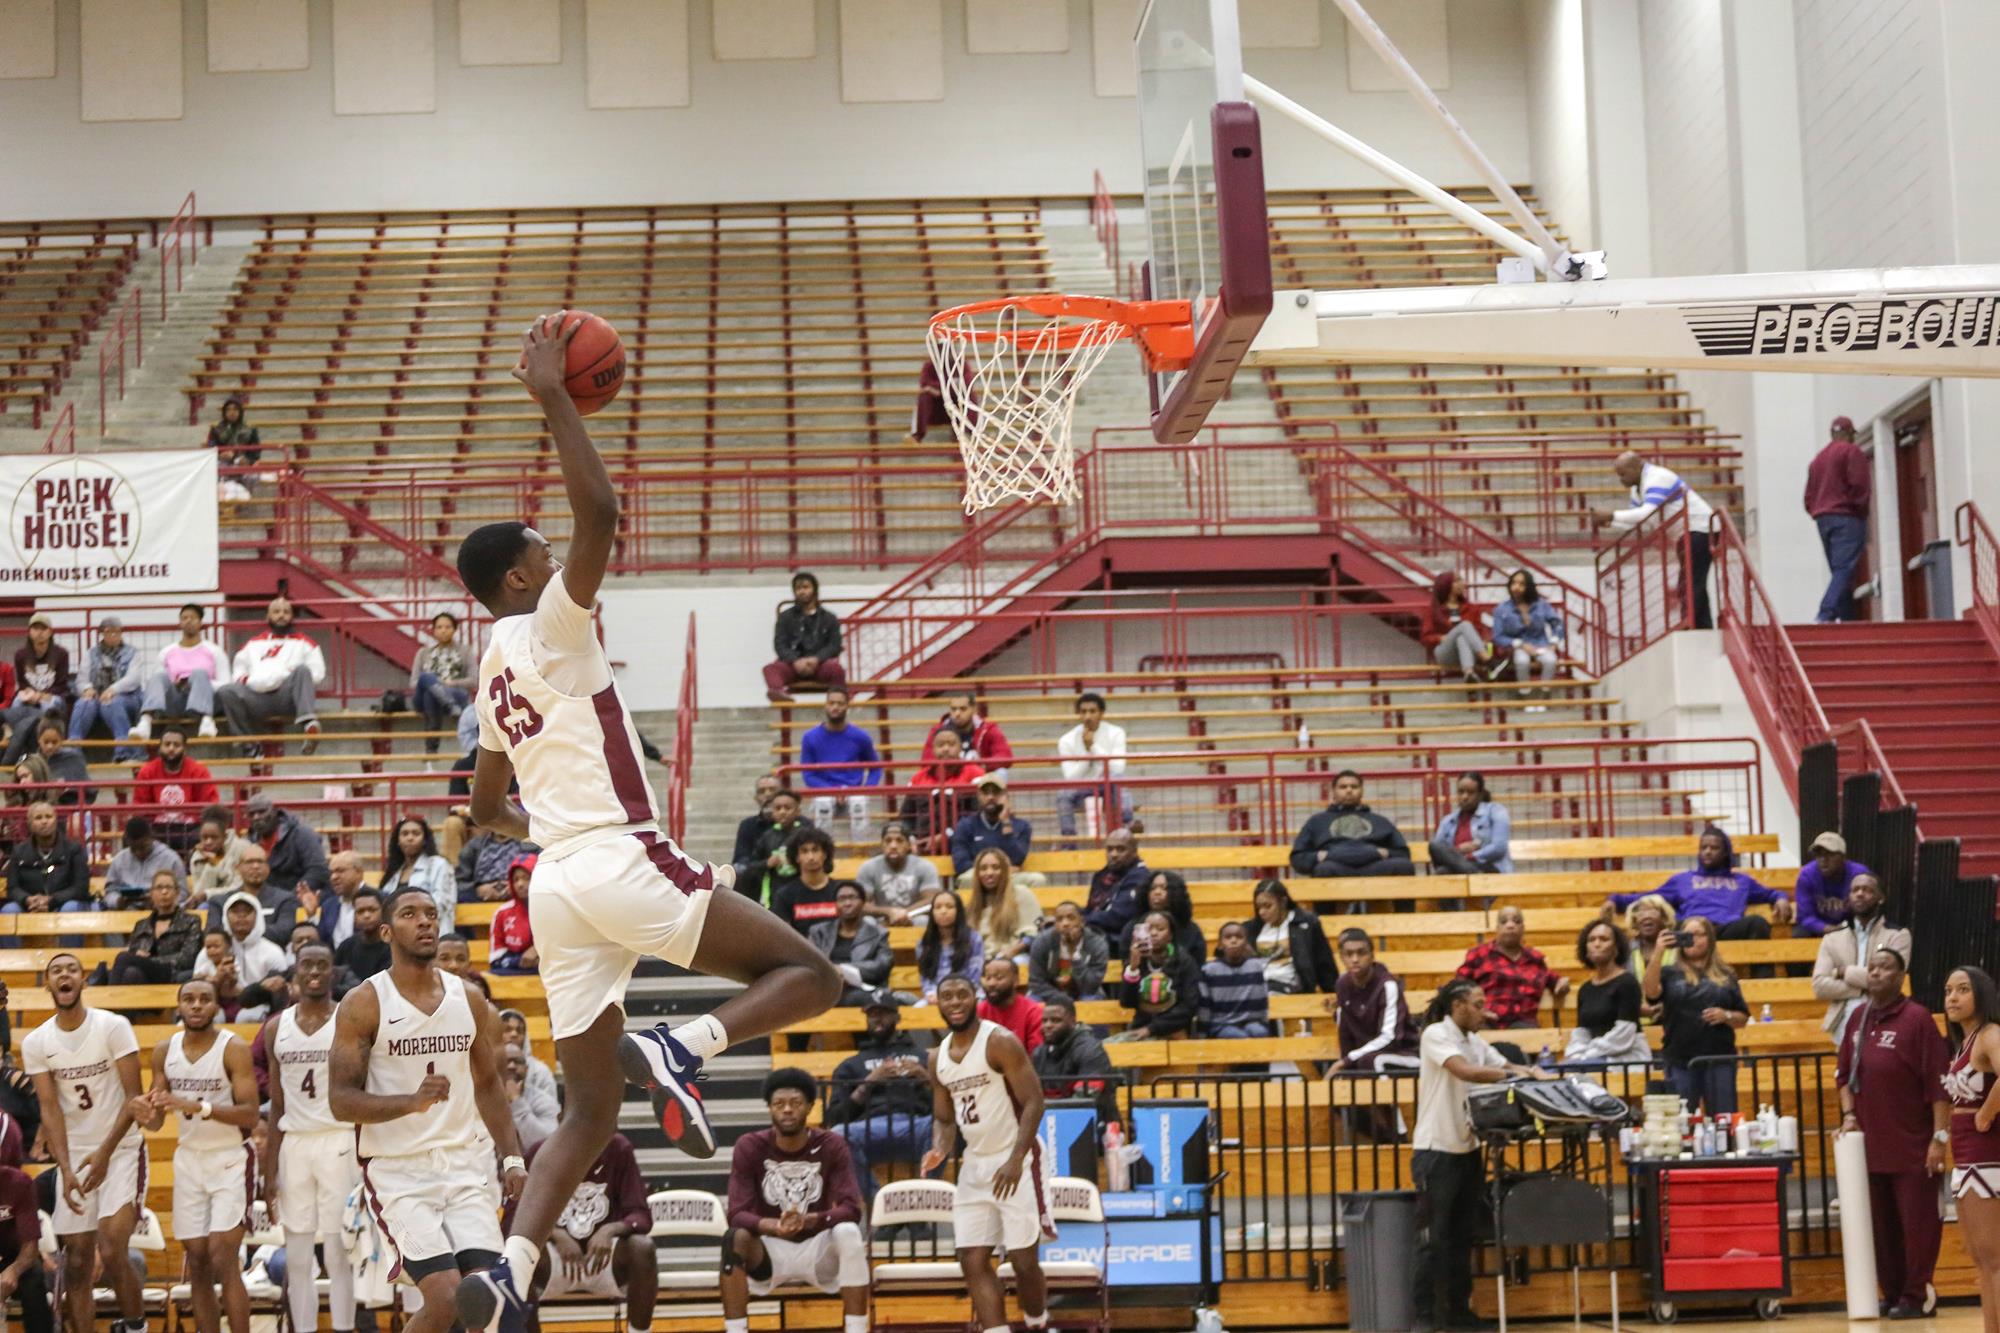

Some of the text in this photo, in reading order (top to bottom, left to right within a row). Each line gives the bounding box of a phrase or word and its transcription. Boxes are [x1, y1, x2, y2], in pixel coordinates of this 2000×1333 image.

[36, 478, 114, 513] PACK
[49, 505, 92, 521] THE
[24, 513, 129, 550] HOUSE!
[0, 564, 171, 582] OREHOUSE COLLEGE
[489, 666, 544, 749] 25
[388, 1035, 471, 1056] MOREHOUSE
[74, 1083, 94, 1111] 3
[301, 1068, 316, 1099] 4
[961, 1094, 980, 1125] 12
[1052, 1187, 1091, 1210] HOUSE
[1045, 1244, 1193, 1265] POWERADE
